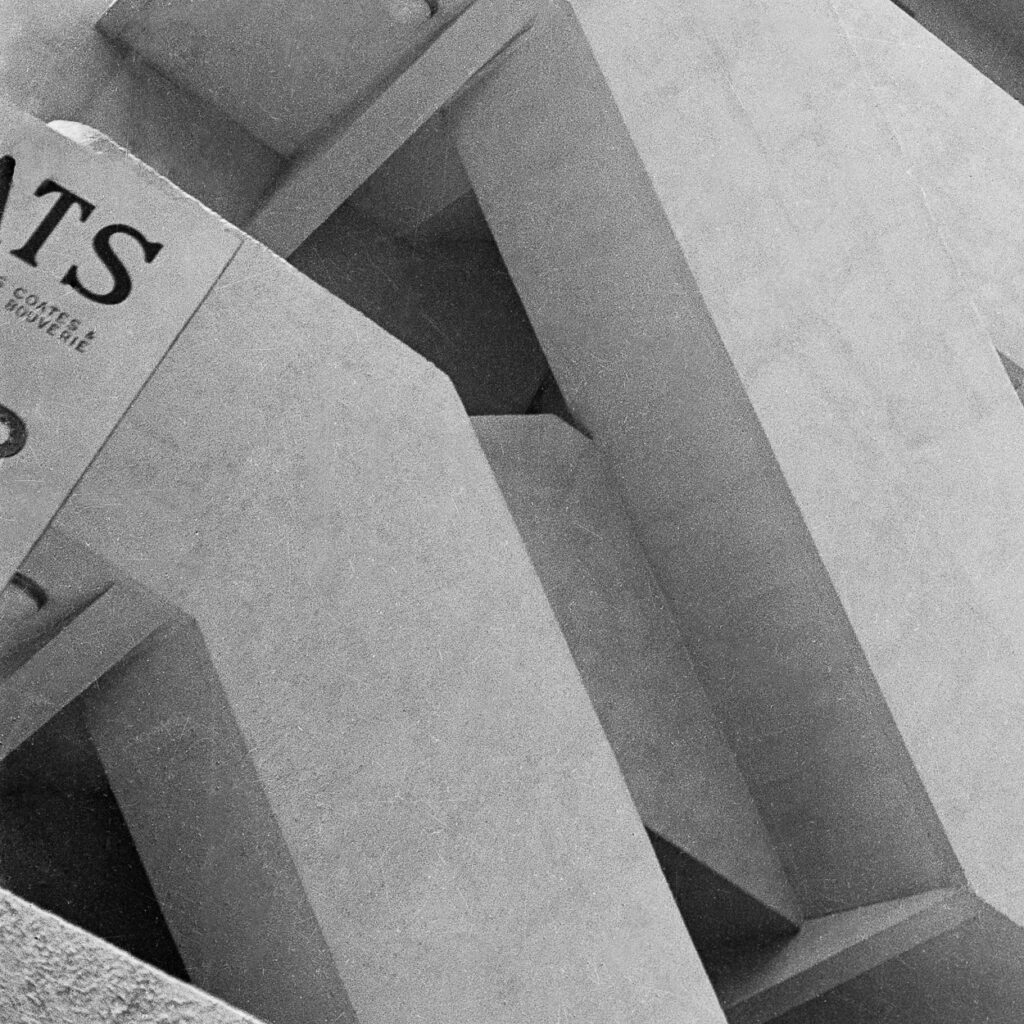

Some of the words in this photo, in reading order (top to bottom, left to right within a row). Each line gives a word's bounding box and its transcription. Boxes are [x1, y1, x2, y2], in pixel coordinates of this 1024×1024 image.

[4, 298, 89, 353] BOUVERIE
[13, 287, 81, 331] COATES
[84, 329, 96, 340] &
